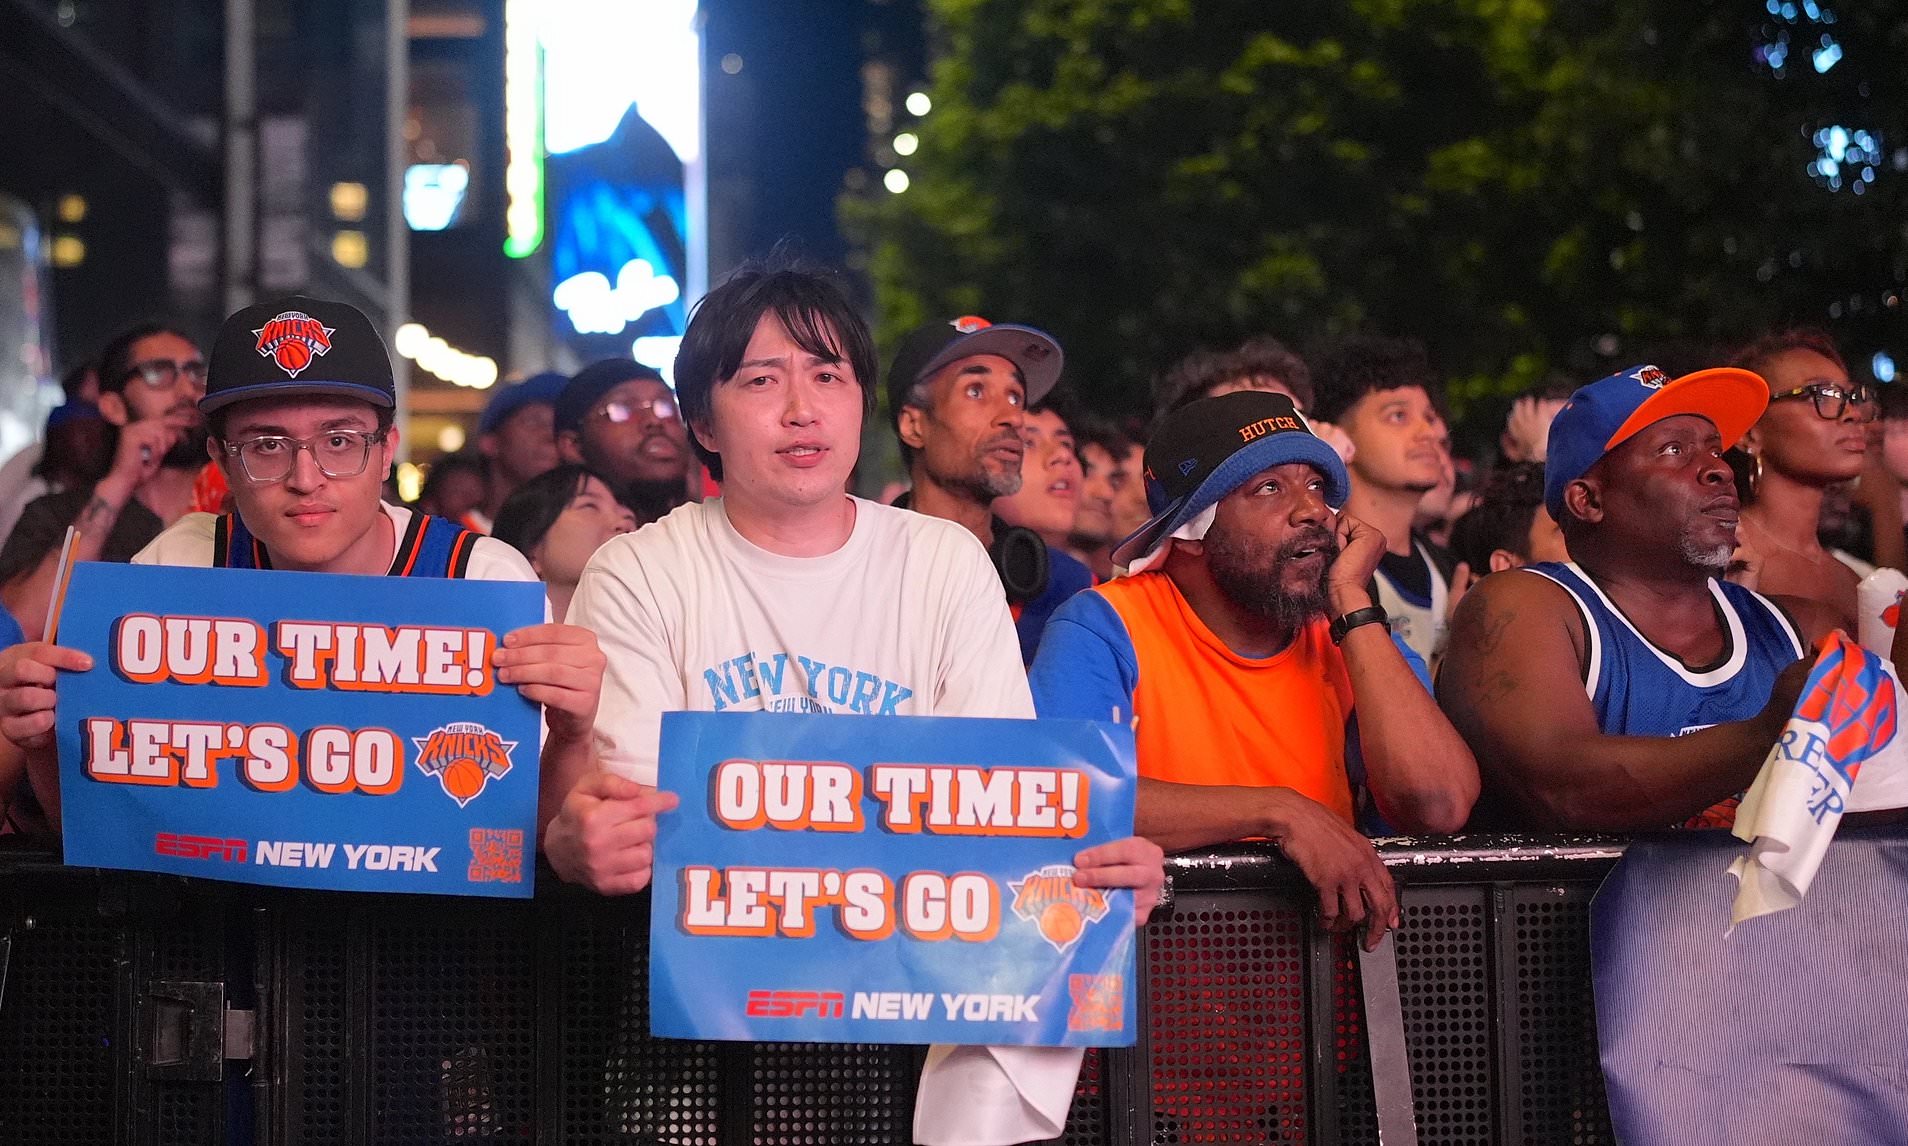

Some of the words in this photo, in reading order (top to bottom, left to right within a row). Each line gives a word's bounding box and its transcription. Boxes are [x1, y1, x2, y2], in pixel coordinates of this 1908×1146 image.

[257, 319, 331, 350] KNICKS
[1239, 416, 1300, 443] HUTCH
[117, 614, 268, 686] OUR
[278, 622, 494, 695] TIME!
[703, 651, 789, 713] NEW
[797, 655, 913, 716] YORK
[306, 726, 403, 793] GO
[417, 731, 510, 768] KNICKS
[714, 759, 863, 831] OUR
[871, 763, 1088, 838] TIME!
[155, 832, 249, 864] ESPN
[254, 841, 335, 869] NEW
[344, 844, 441, 873] YORK
[902, 869, 1000, 940] GO
[745, 990, 844, 1018] ESPN
[851, 992, 934, 1021] NEW
[940, 993, 1041, 1023] YORK
